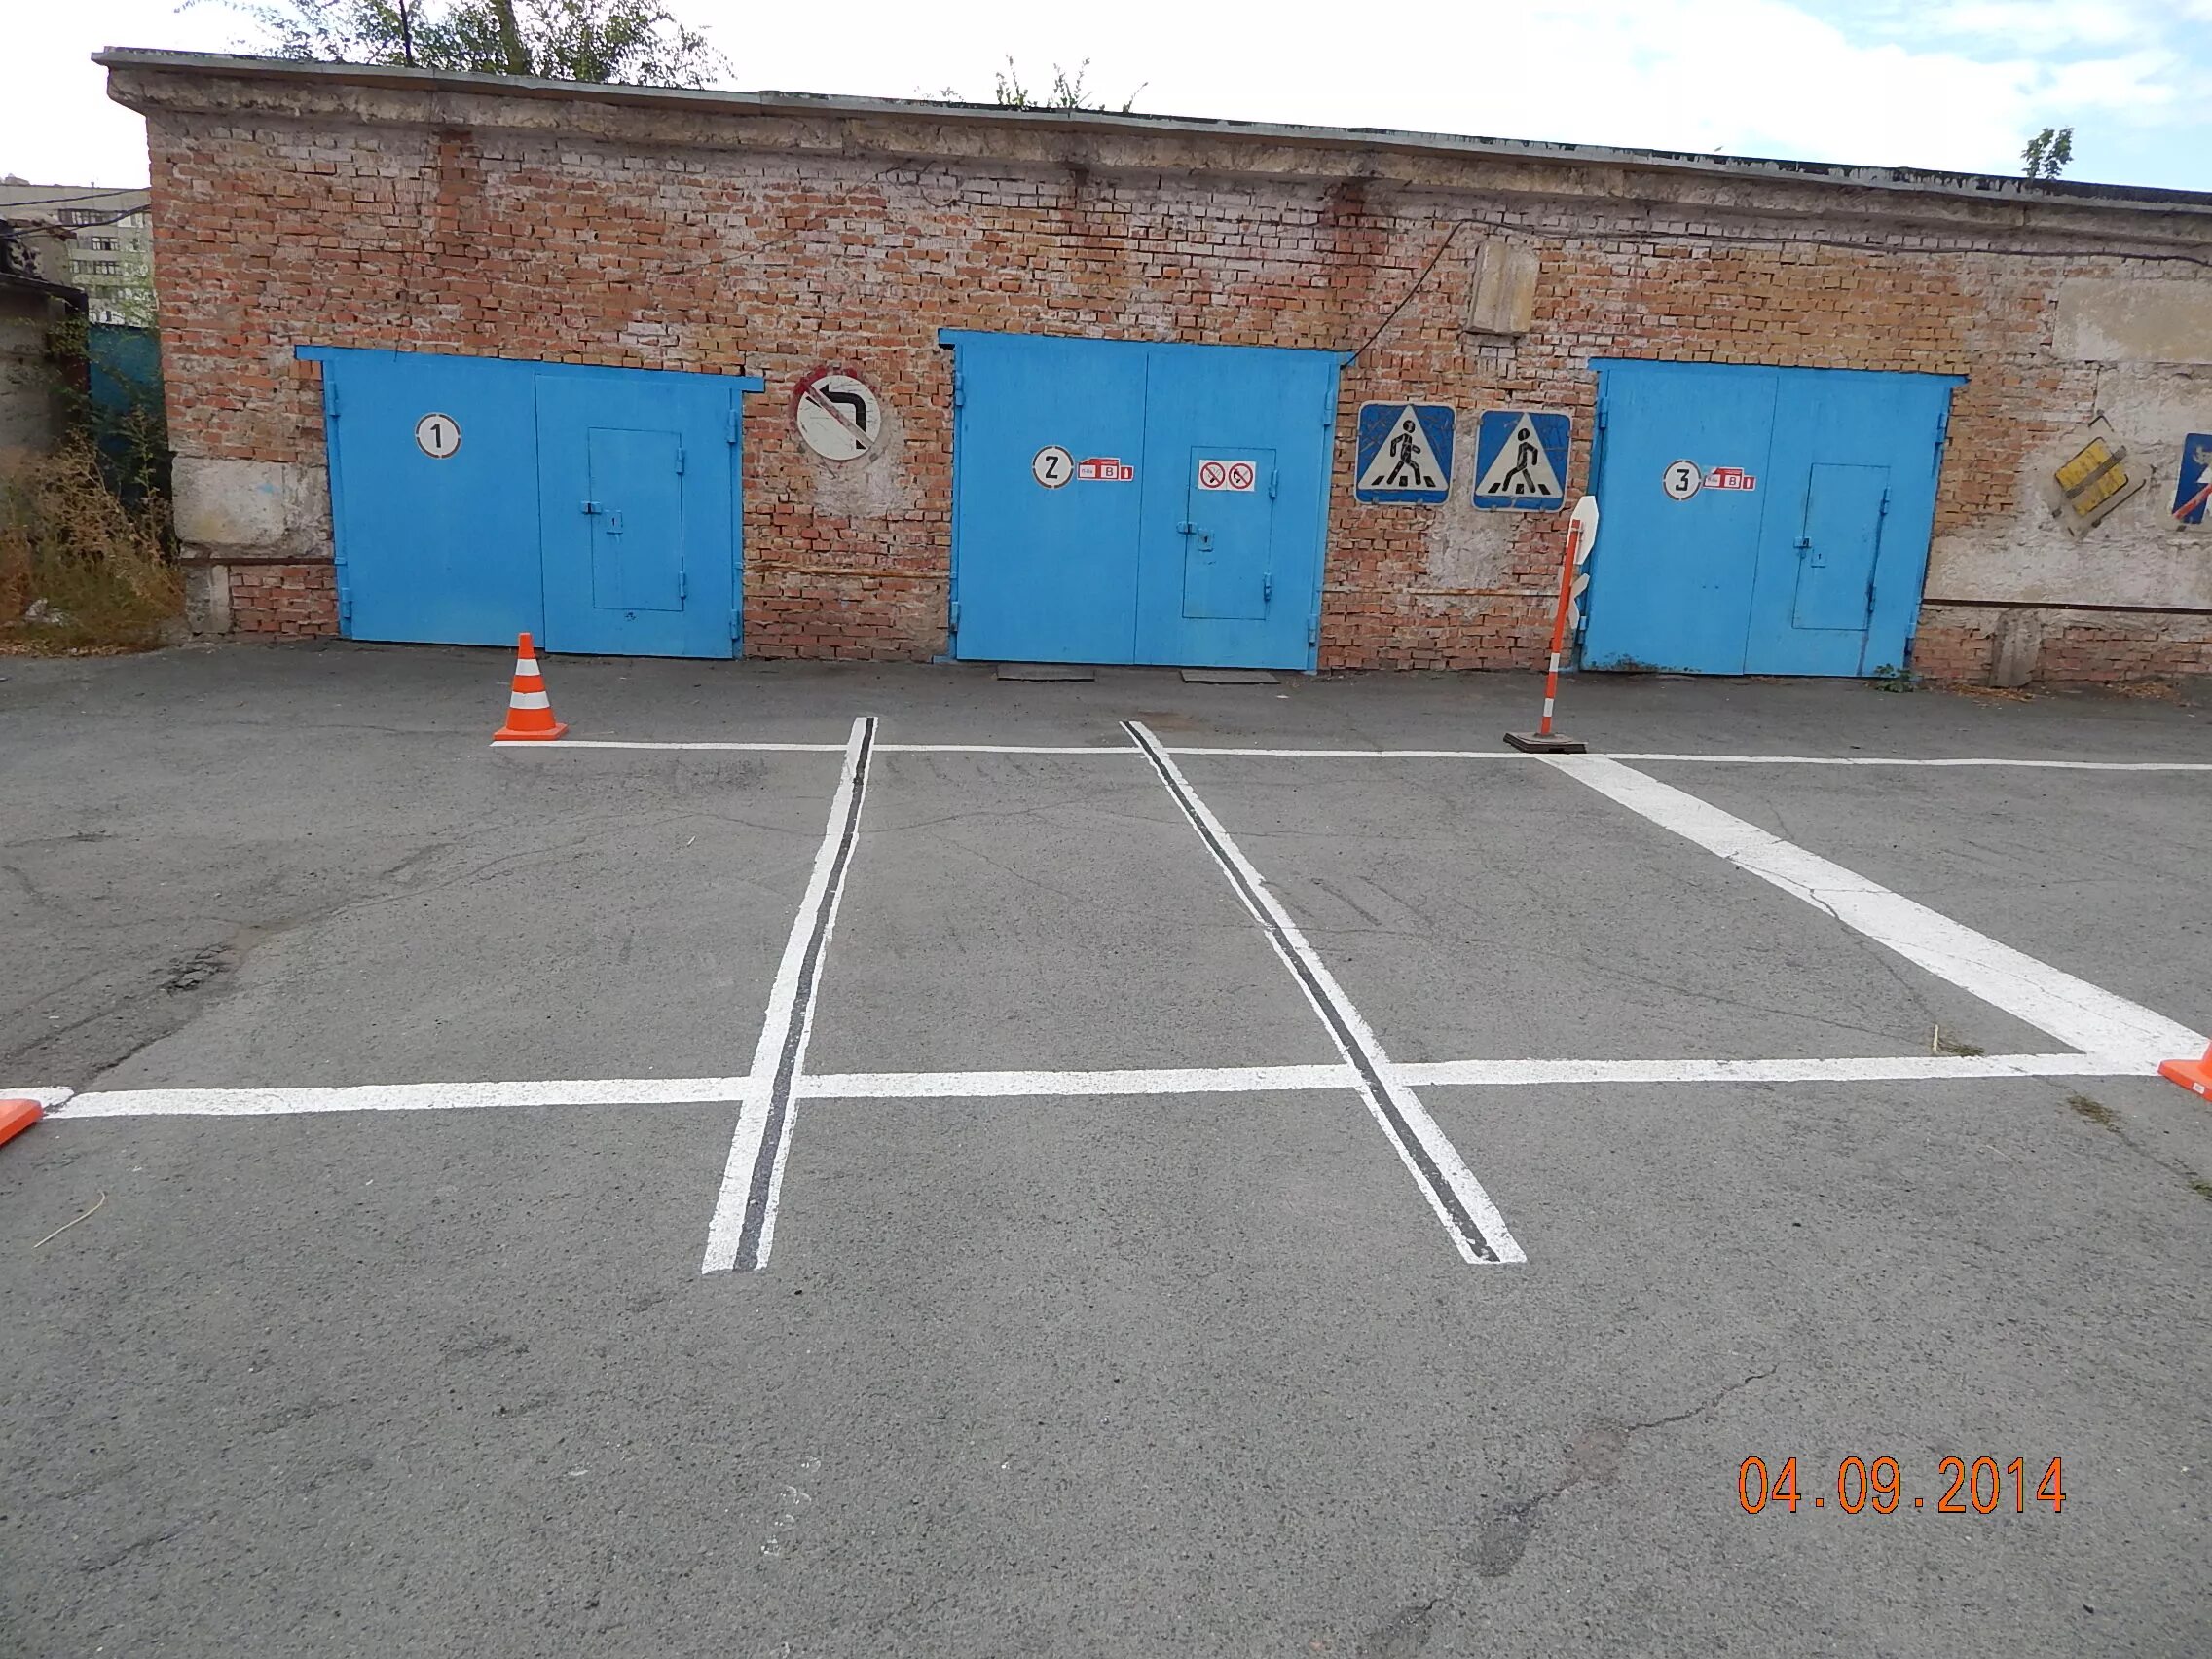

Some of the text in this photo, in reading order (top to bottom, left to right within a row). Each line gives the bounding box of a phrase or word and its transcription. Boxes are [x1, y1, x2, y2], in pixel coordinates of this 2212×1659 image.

[430, 424, 441, 448] 1
[1045, 456, 1059, 479] 2
[1675, 469, 1690, 491] 3
